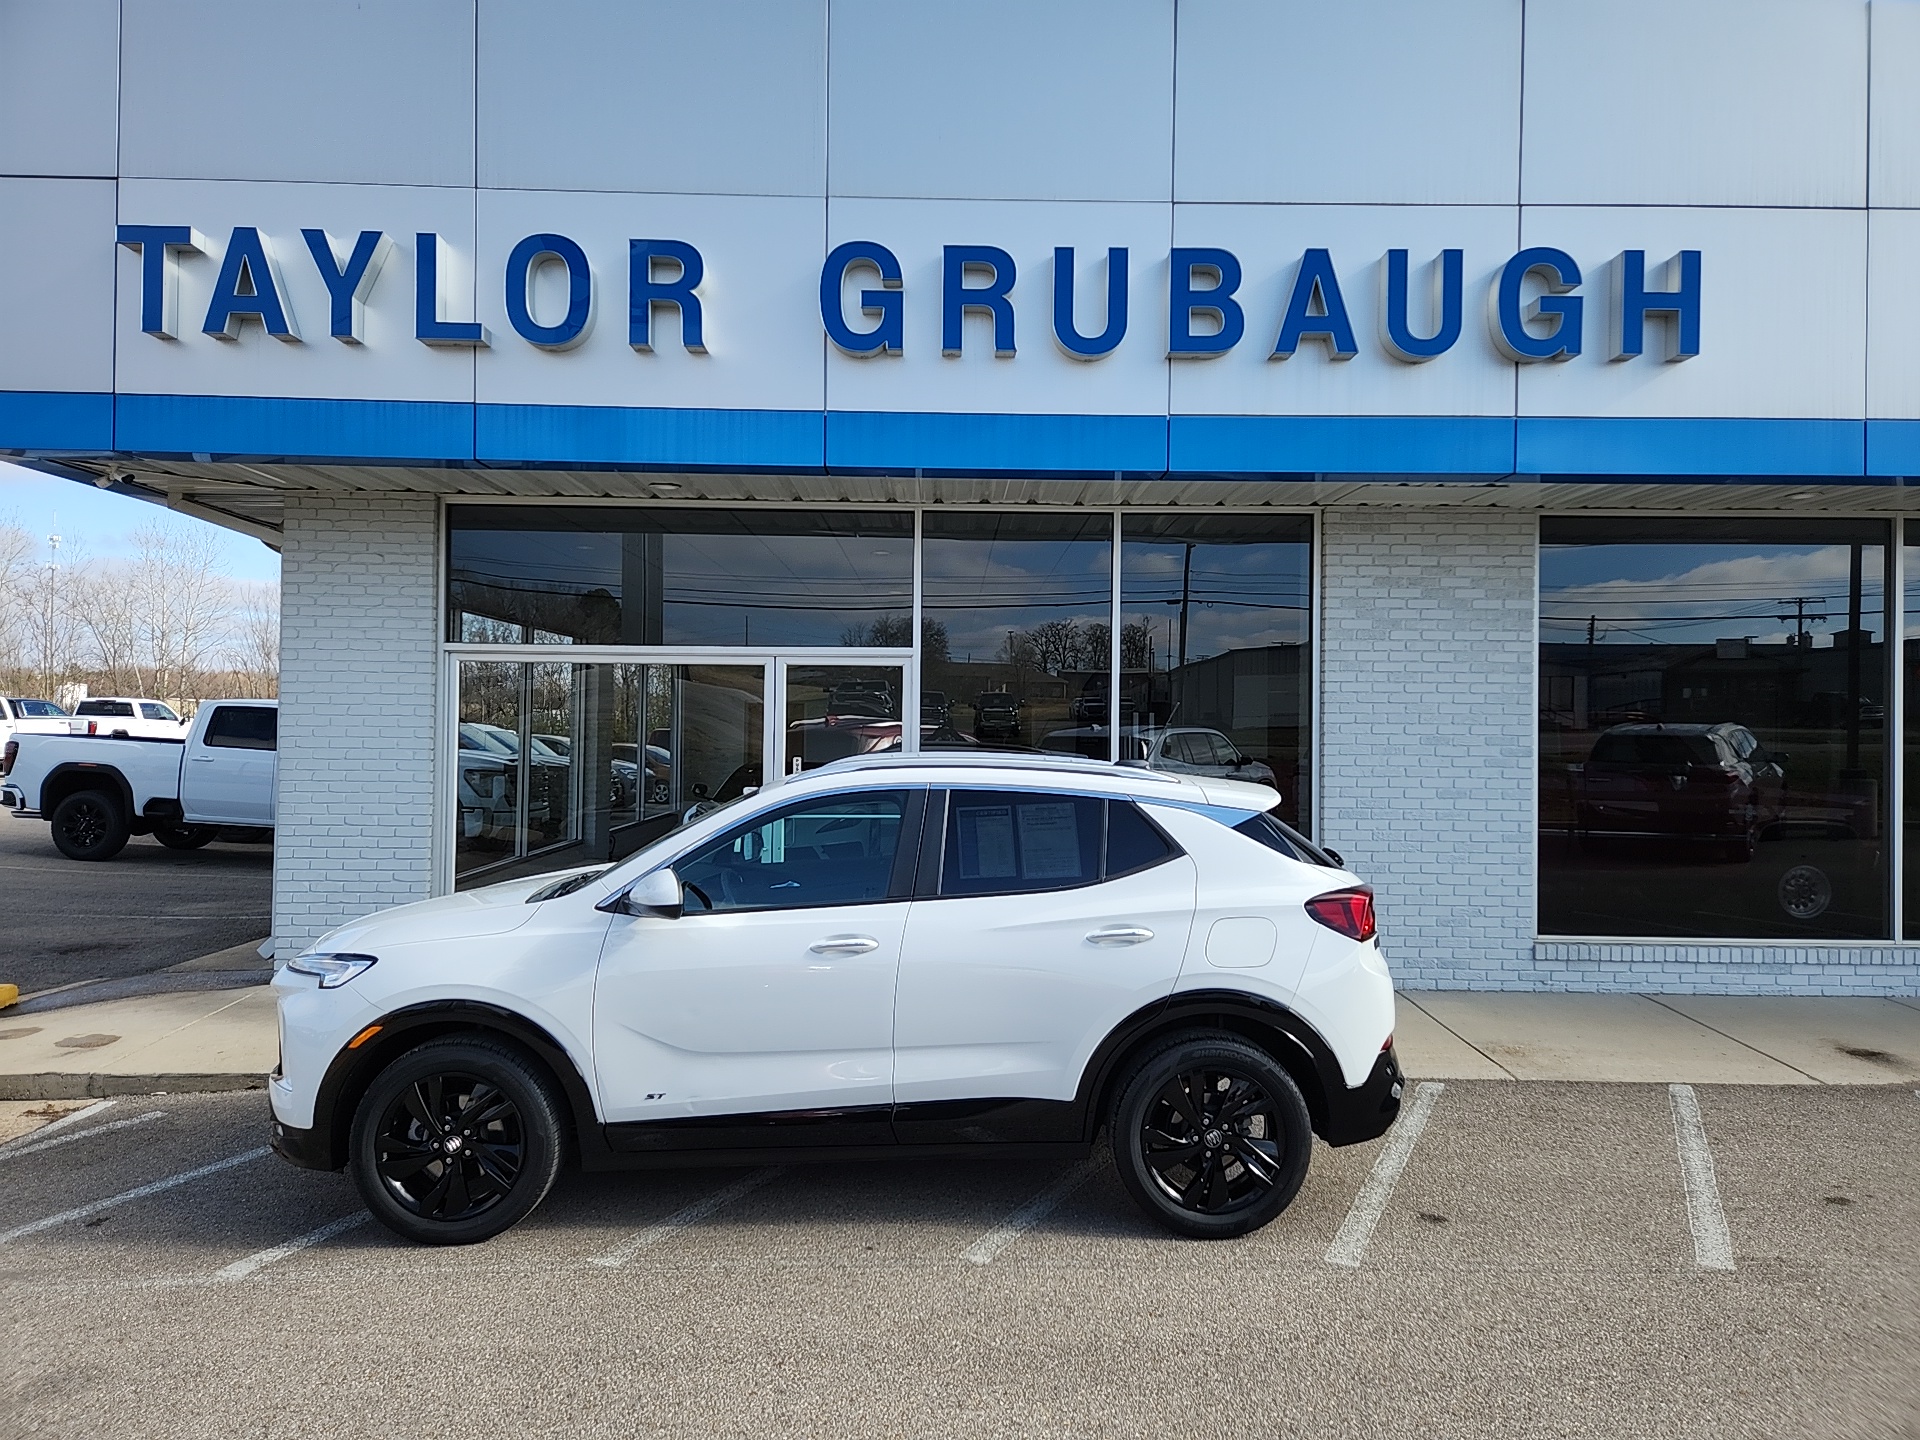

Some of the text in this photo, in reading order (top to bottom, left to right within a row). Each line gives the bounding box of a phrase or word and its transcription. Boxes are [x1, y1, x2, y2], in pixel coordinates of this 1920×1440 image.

[114, 224, 1702, 361] TAYLOR GRUBAUGH
[643, 1092, 667, 1101] ST
